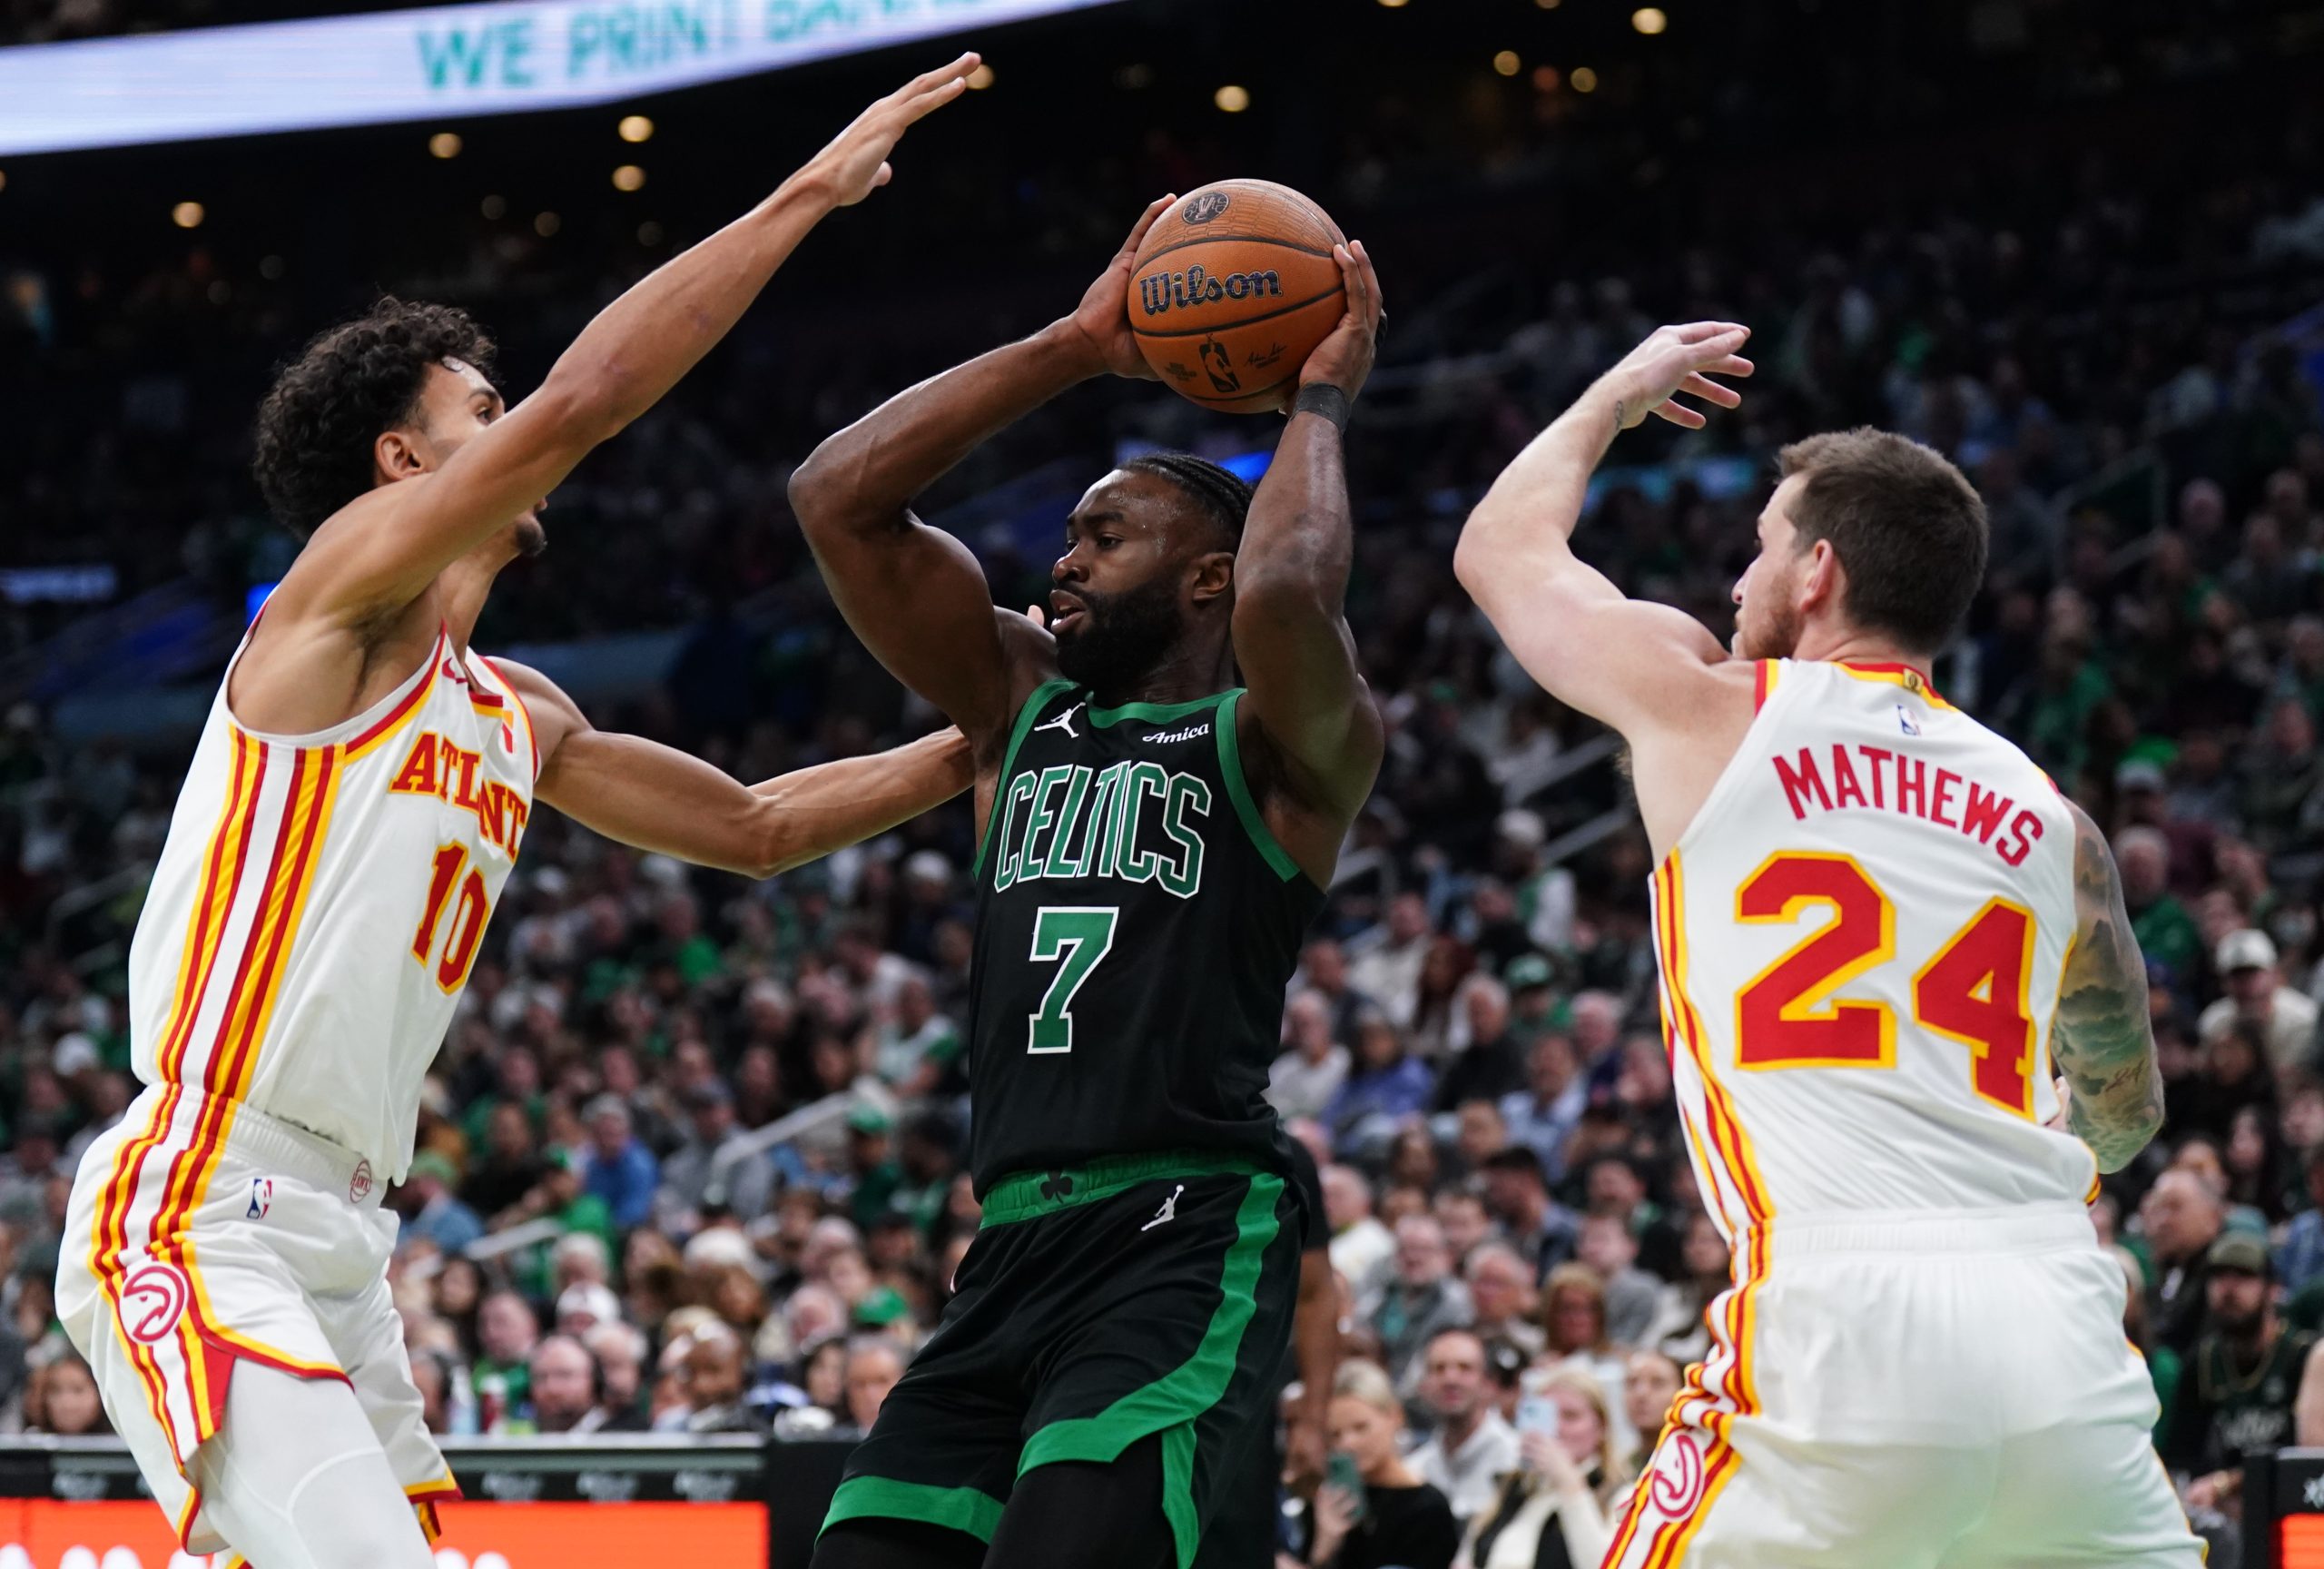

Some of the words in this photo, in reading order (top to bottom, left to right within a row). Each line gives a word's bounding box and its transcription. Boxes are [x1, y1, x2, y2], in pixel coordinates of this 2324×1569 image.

[416, 18, 535, 90] WE
[1140, 264, 1279, 316] Wilson
[389, 732, 527, 864] ATLNT
[1142, 723, 1209, 744] Amica
[994, 760, 1212, 899] CELTICS
[1772, 744, 2043, 867] MATHEWS
[411, 840, 492, 996] 10
[1027, 906, 1119, 1054] 7
[1734, 850, 2035, 1123] 24
